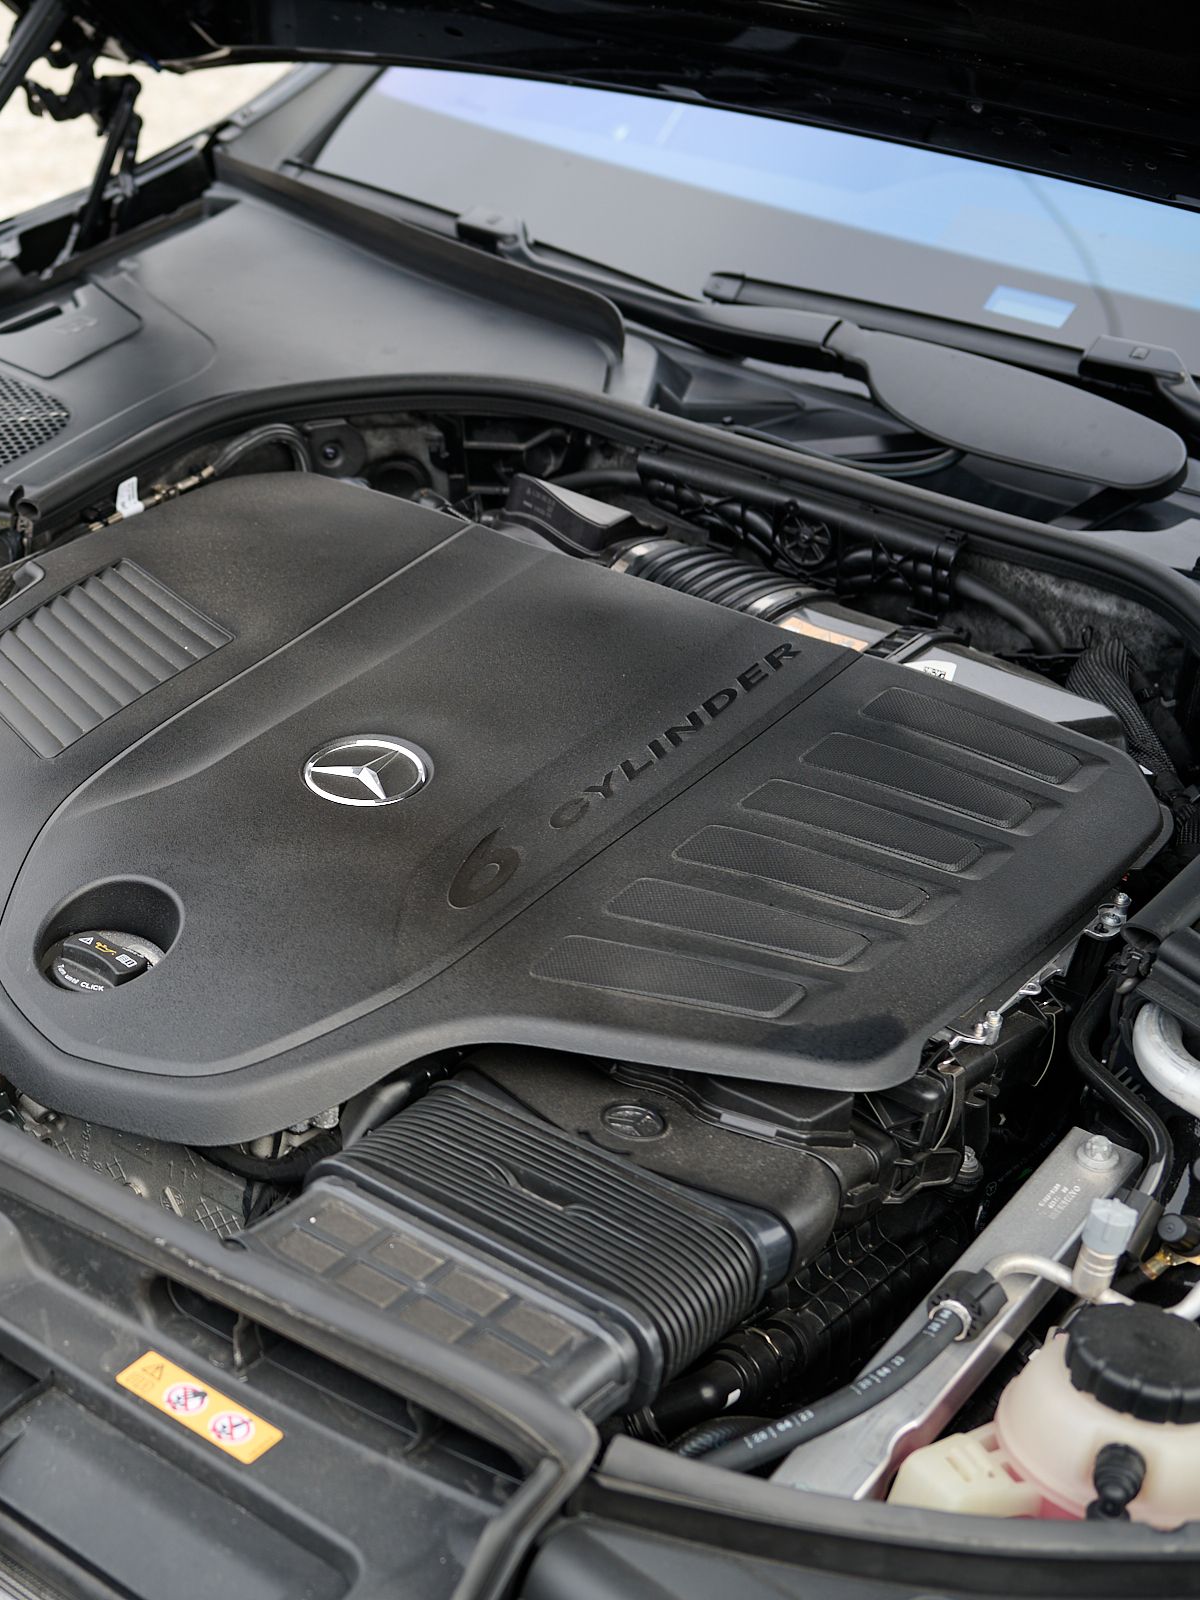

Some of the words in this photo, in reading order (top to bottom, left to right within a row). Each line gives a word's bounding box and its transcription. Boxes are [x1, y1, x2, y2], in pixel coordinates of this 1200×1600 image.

[446, 826, 525, 909] 6
[548, 641, 803, 830] CYLINDER
[64, 974, 79, 985] until
[80, 982, 104, 992] CLICK
